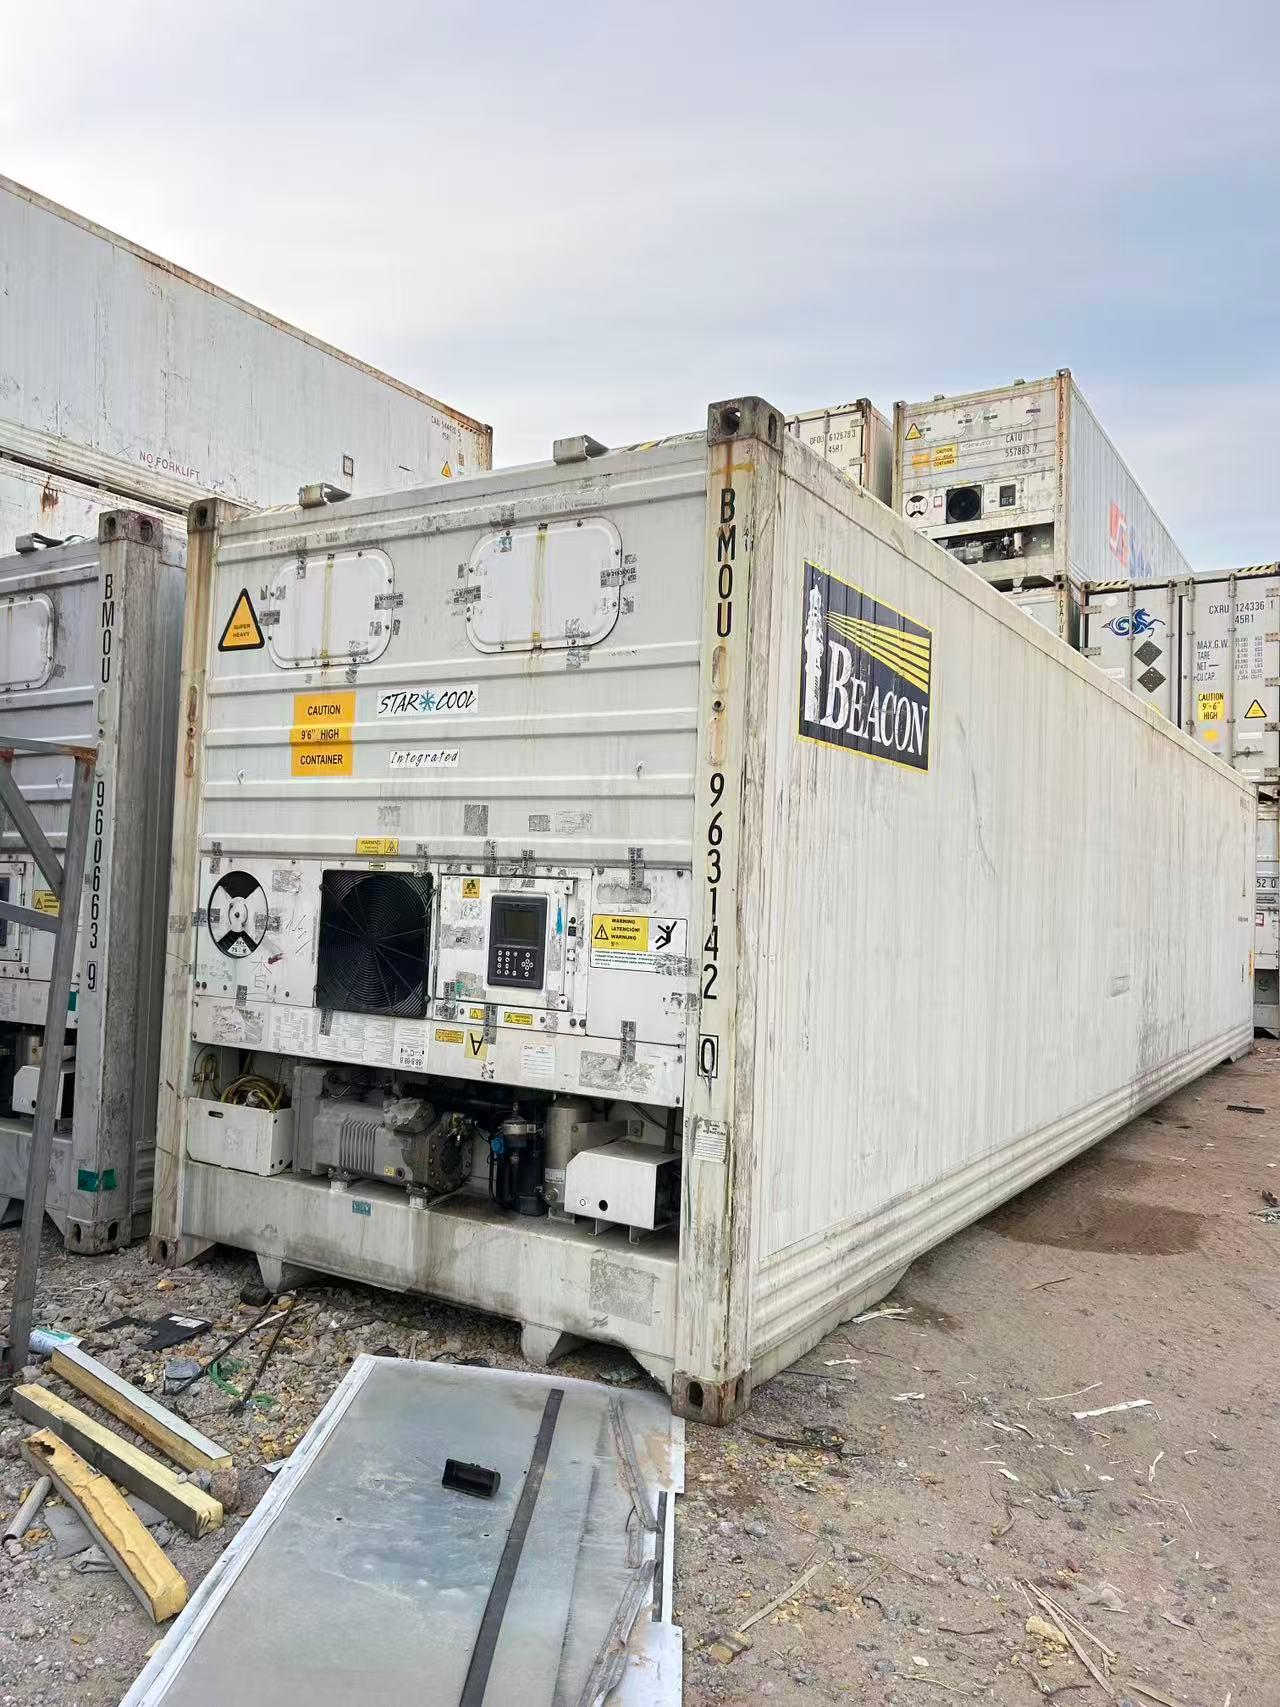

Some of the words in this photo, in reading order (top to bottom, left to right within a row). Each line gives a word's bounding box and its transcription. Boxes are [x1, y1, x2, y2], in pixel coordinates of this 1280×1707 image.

[828, 444, 843, 453] 45R1
[1005, 445, 1030, 457] 557883
[1033, 443, 1038, 453] 7
[139, 449, 154, 464] NO
[155, 456, 200, 480] FORKLIFT
[716, 488, 737, 638] BMOU
[1209, 604, 1230, 614] CXRU
[1235, 601, 1265, 612] 124336
[1270, 600, 1274, 609] 1
[1235, 614, 1254, 624] 45R1
[101, 573, 114, 683] BMOU
[1197, 651, 1210, 660] TARE
[1197, 661, 1207, 671] NET
[378, 690, 420, 715] STAR
[435, 689, 476, 711] COOL
[820, 640, 928, 756] BEACON
[1198, 692, 1224, 701] CAUTION
[307, 704, 341, 716] CAUTION
[1203, 711, 1218, 720] HIGH
[320, 729, 340, 740] HIGH
[300, 754, 343, 765] CONTAINER
[390, 750, 459, 767] Integrated
[90, 781, 105, 949] 960663
[702, 773, 726, 1000] 963142
[1270, 878, 1277, 889] 0
[88, 962, 97, 991] 9
[700, 1037, 716, 1075] 0
